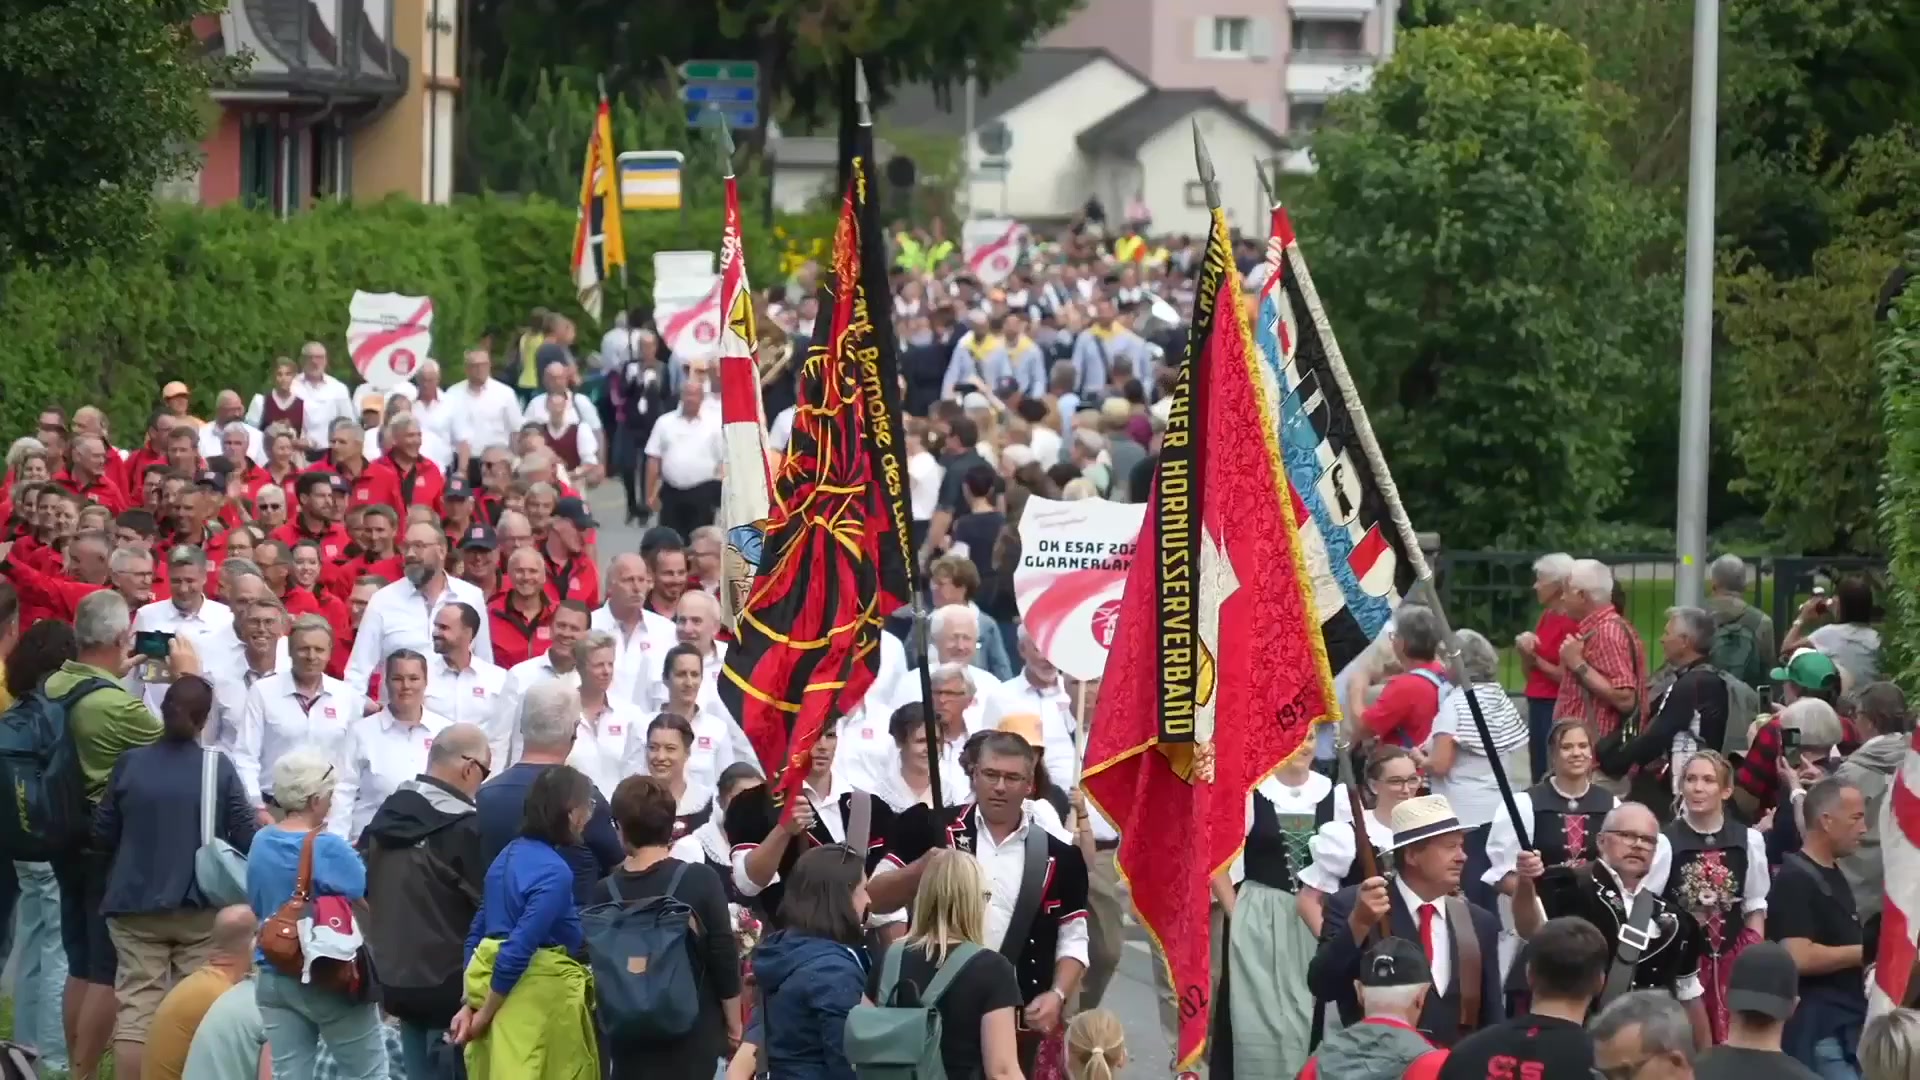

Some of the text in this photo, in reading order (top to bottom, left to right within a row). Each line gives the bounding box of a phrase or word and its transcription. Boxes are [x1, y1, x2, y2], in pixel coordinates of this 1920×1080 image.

[857, 345, 893, 449] Bernoise
[880, 453, 902, 496] des
[1024, 555, 1133, 571] GLARNERLAN
[1039, 539, 1137, 556] OK ESAF 202
[1161, 459, 1194, 735] HORNUSSERVERBAND
